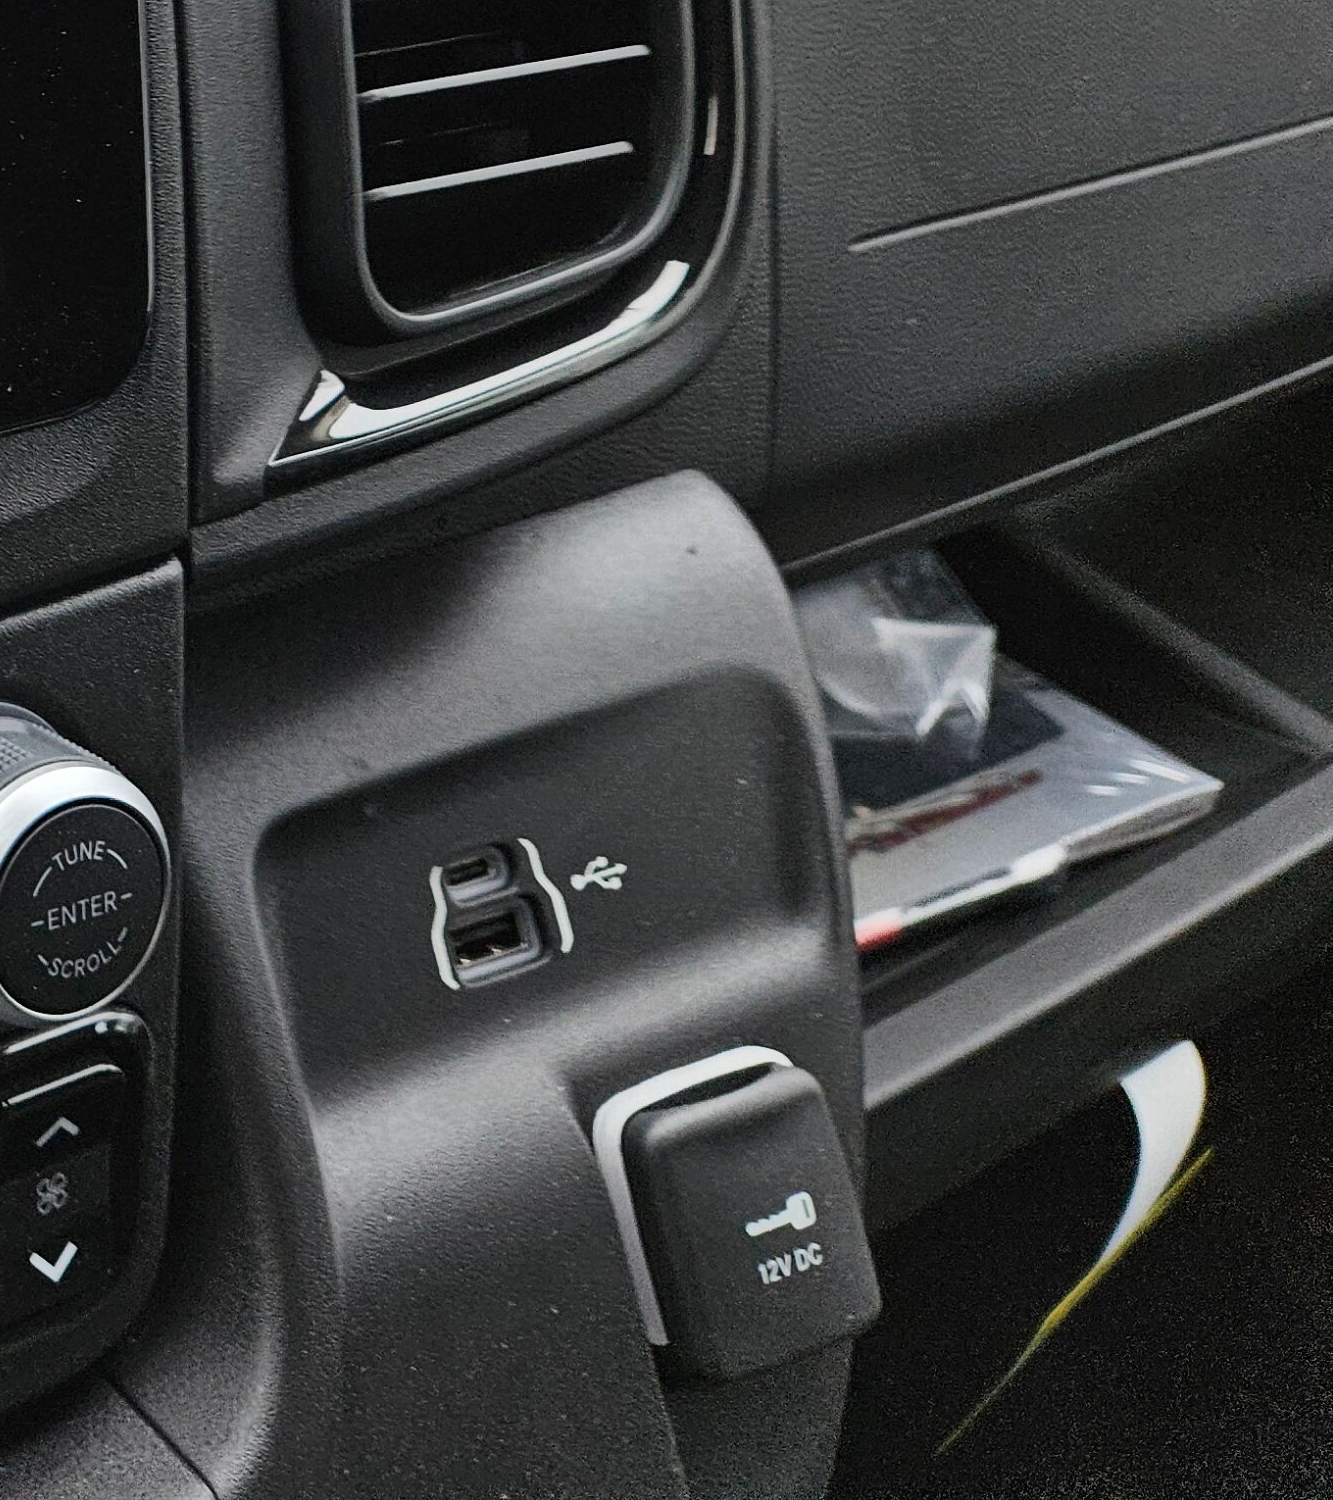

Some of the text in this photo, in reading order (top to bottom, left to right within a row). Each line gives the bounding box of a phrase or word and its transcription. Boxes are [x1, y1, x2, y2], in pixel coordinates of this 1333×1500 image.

[51, 840, 105, 871] TUNE
[47, 890, 118, 932] ENTER
[46, 941, 122, 979] SCROLL
[758, 1242, 823, 1285] 12V DC
